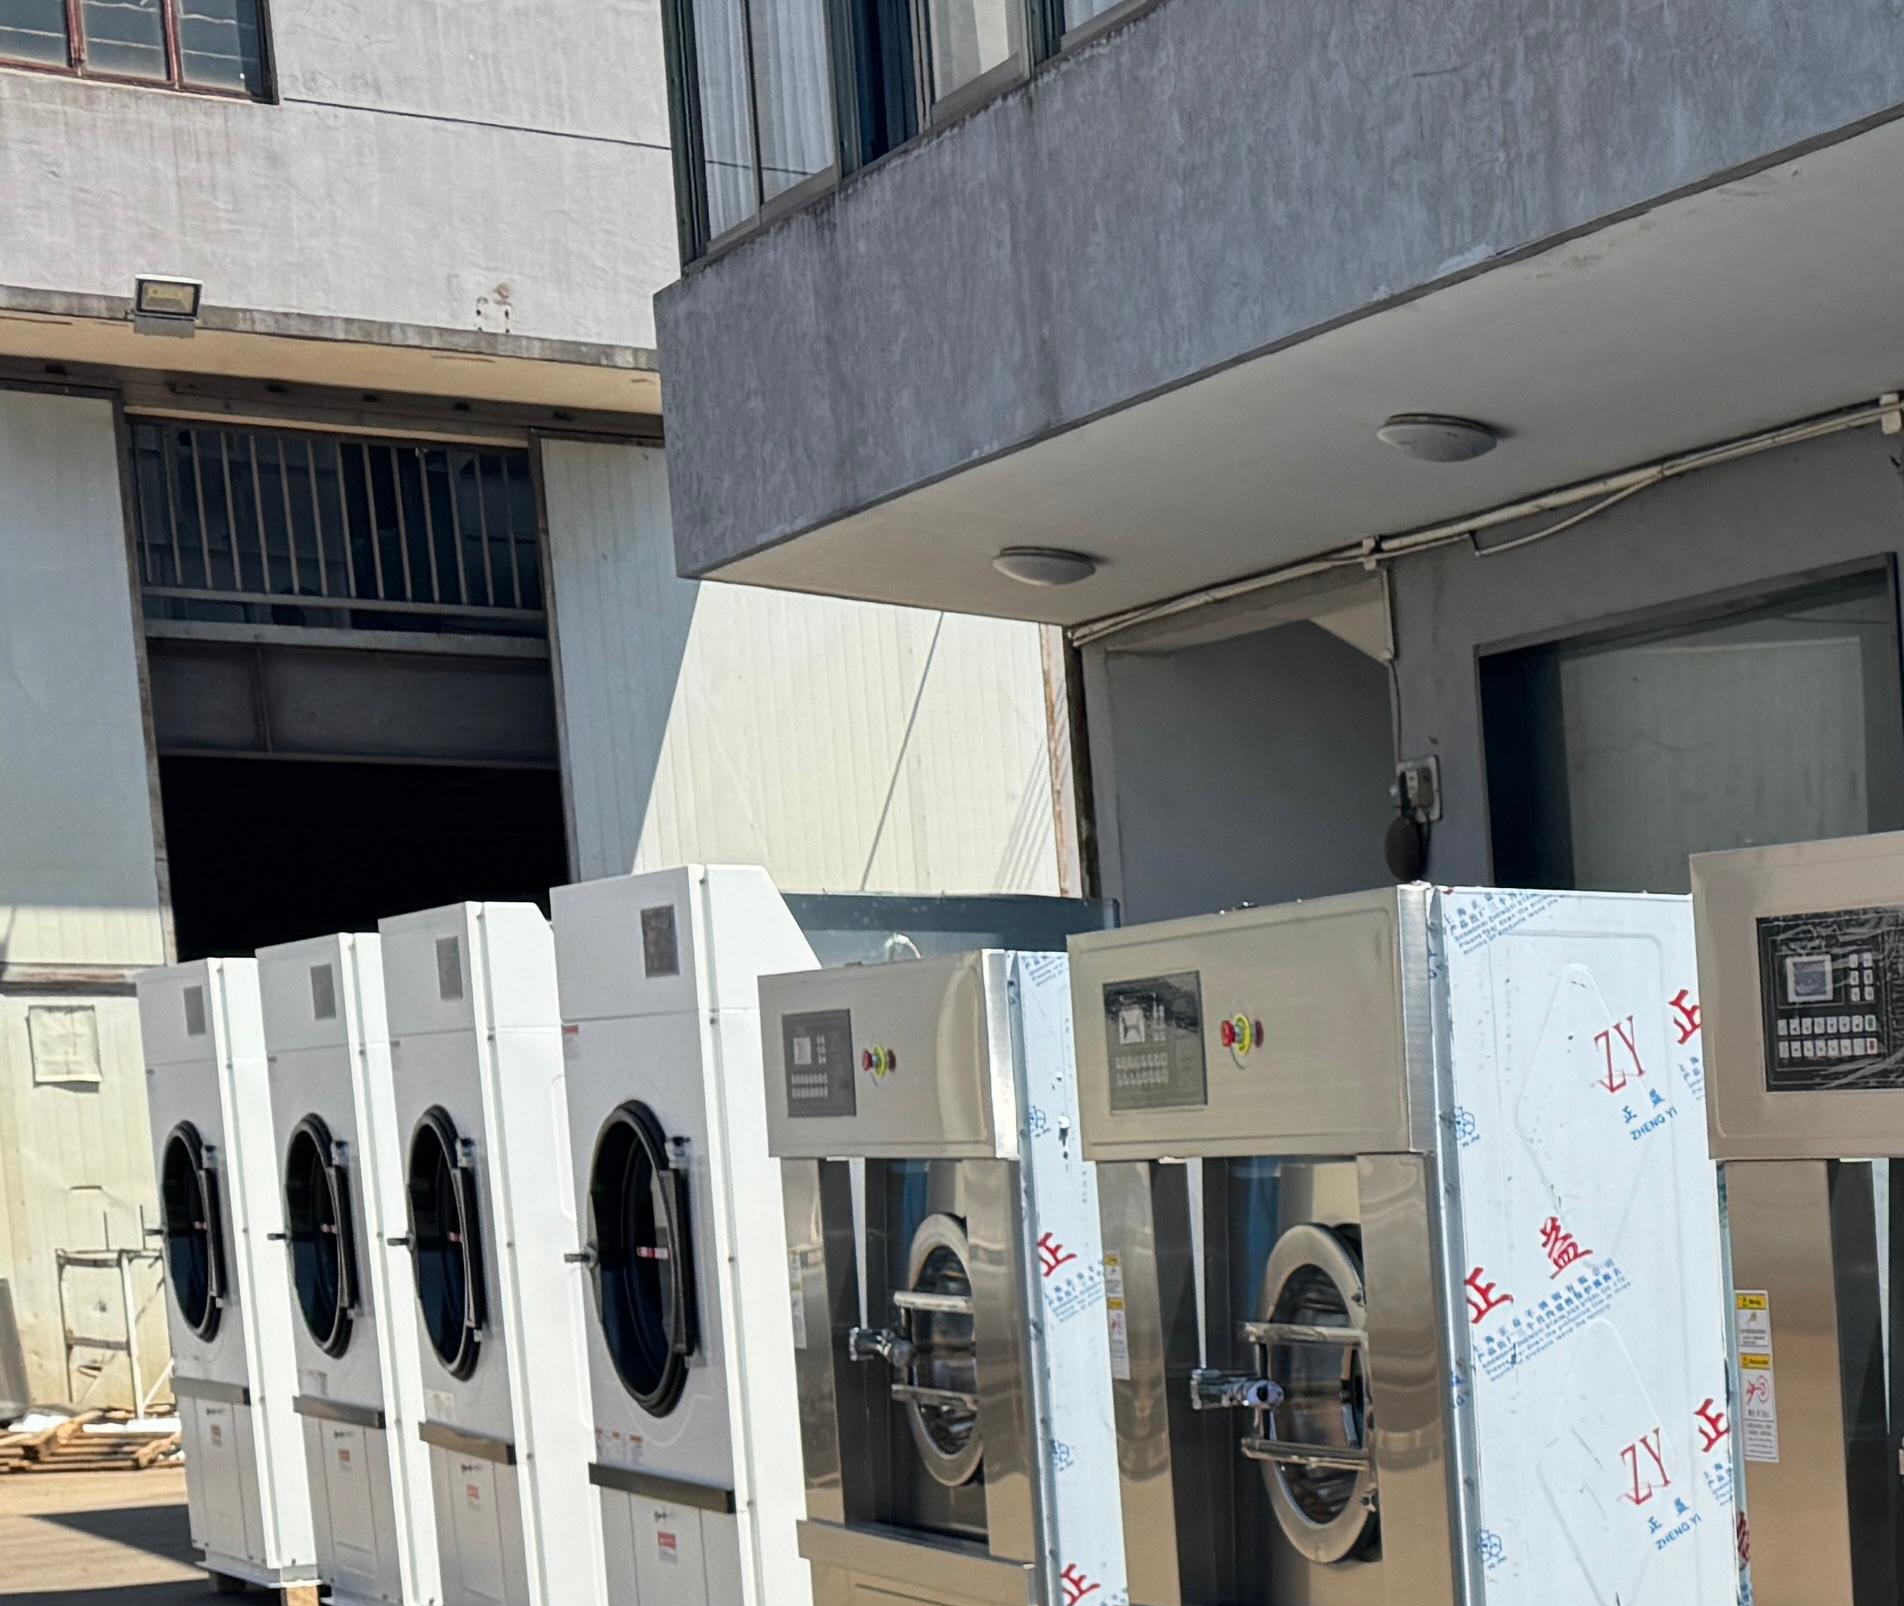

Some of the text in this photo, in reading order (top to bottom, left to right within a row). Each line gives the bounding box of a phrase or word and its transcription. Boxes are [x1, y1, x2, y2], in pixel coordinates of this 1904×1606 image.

[1591, 1015, 1646, 1093] ZY
[1630, 1106, 1678, 1142] ZHENG YI
[1617, 1428, 1673, 1506] ZY
[1655, 1512, 1702, 1551] ZHENG YI
